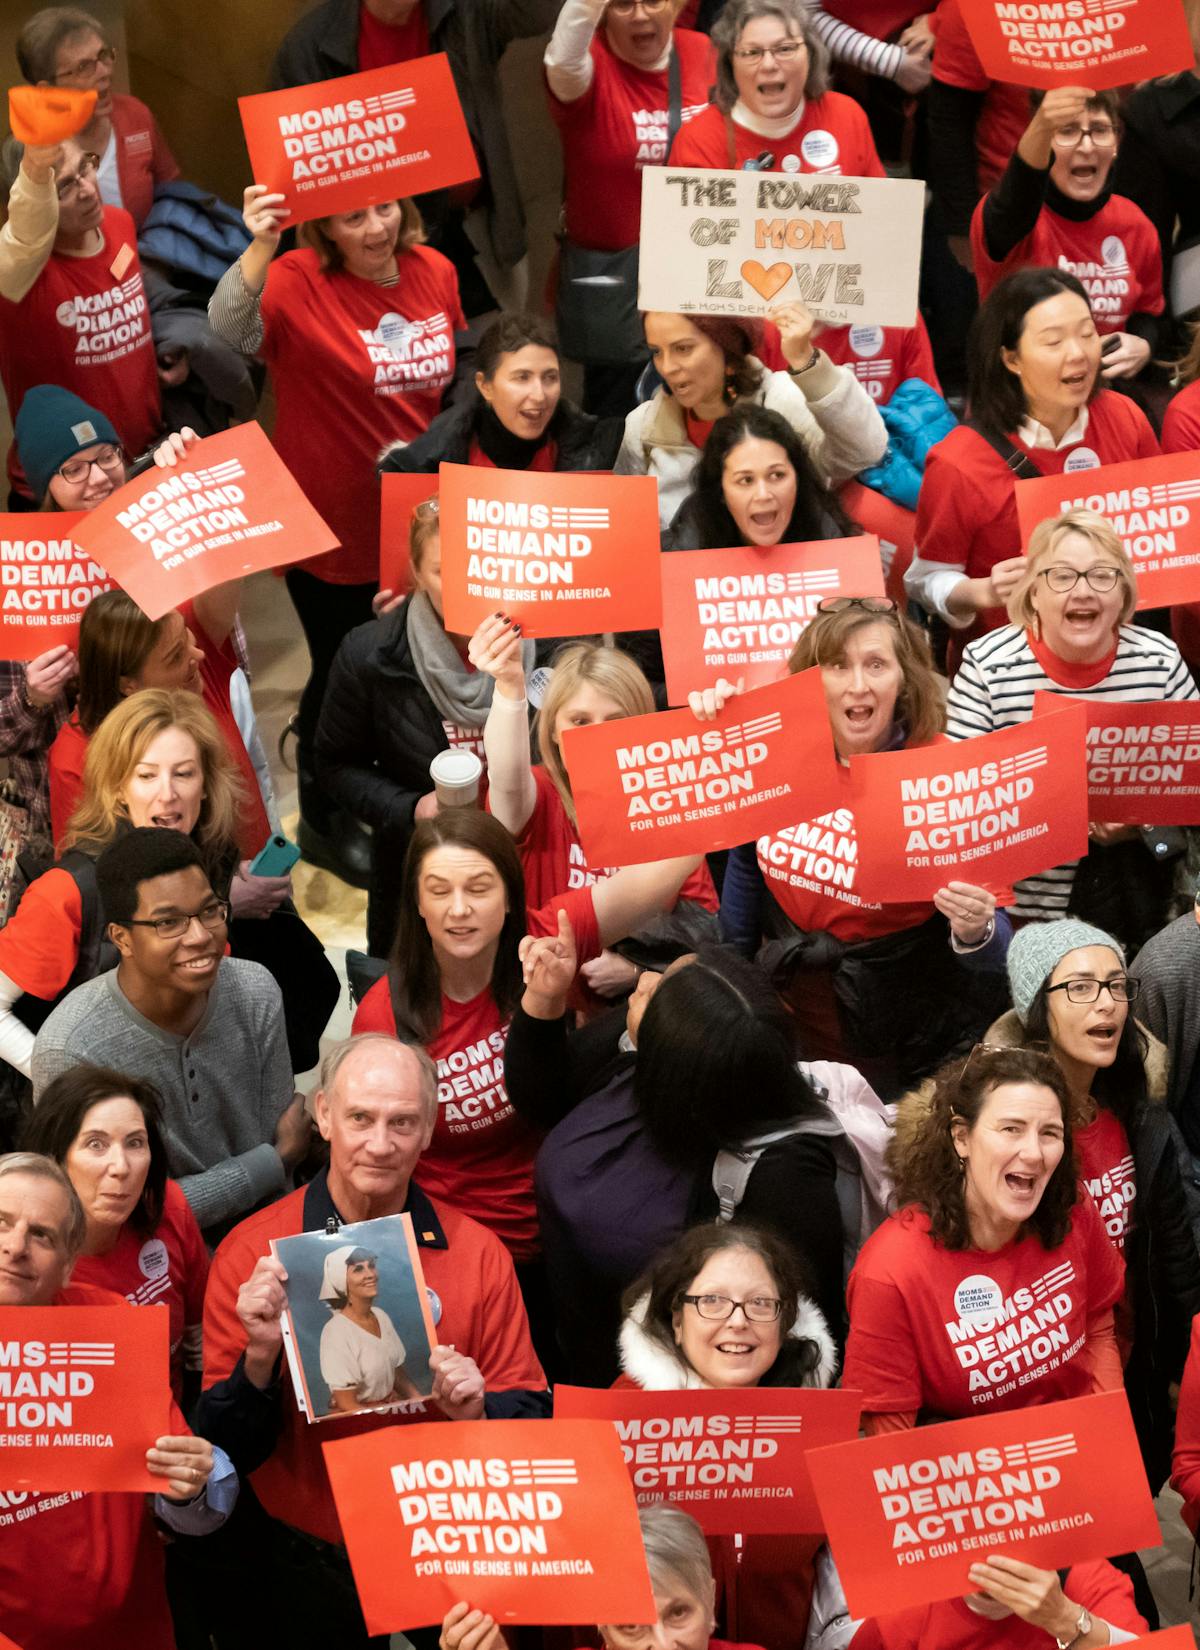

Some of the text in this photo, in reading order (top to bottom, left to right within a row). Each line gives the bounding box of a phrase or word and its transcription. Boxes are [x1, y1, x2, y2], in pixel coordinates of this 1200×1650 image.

[994, 1, 1085, 20] MOMS
[1000, 12, 1126, 39] DEMAND
[1008, 34, 1114, 58] ACTION
[278, 99, 366, 136] MOMS
[283, 112, 406, 159] DEMAND
[292, 136, 397, 180] ACTION
[665, 176, 862, 214] THE POWER
[689, 217, 846, 250] OF MOM
[705, 258, 865, 306] LVE
[75, 317, 143, 353] ACTION
[374, 354, 449, 385] ACTION
[115, 470, 202, 528] MOMS
[129, 484, 246, 544] DEMAND
[466, 497, 550, 529] MOMS
[149, 505, 250, 562] ACTION
[1109, 505, 1190, 536] MAND
[466, 526, 592, 558] DEMAND
[1, 561, 109, 586] DEMAN
[467, 554, 573, 585] ACTION
[694, 572, 786, 600] MOMS
[615, 730, 724, 770] MOMS
[621, 742, 769, 794] DEMAND
[900, 762, 999, 802] MOMS
[1088, 764, 1185, 783] CTION
[627, 769, 754, 818] ACTION
[902, 776, 1034, 827] DEMAND
[905, 805, 1020, 852] ACTION
[756, 835, 855, 889] ACTION
[958, 1287, 983, 1296] MOMS
[959, 1293, 993, 1303] DEMAND
[960, 1301, 990, 1310] ACTION
[955, 1292, 1073, 1368] DEMAND
[968, 1323, 1070, 1392] ACTION
[971, 1357, 1060, 1405] FOR GUN SENSE IN
[613, 1415, 731, 1441] MOMS
[390, 1458, 510, 1494] MOMS
[634, 1463, 753, 1488] CTION
[872, 1447, 1003, 1493] MOMS
[399, 1491, 563, 1526] DEMAND
[881, 1465, 1061, 1521] DEMAND
[892, 1495, 1045, 1549] ACTION
[896, 1512, 1094, 1566] FOR GUN SENSE IN AMERICA
[410, 1524, 548, 1557] ACTION
[414, 1559, 594, 1577] FOR GUN SENSE IN AMERICA
